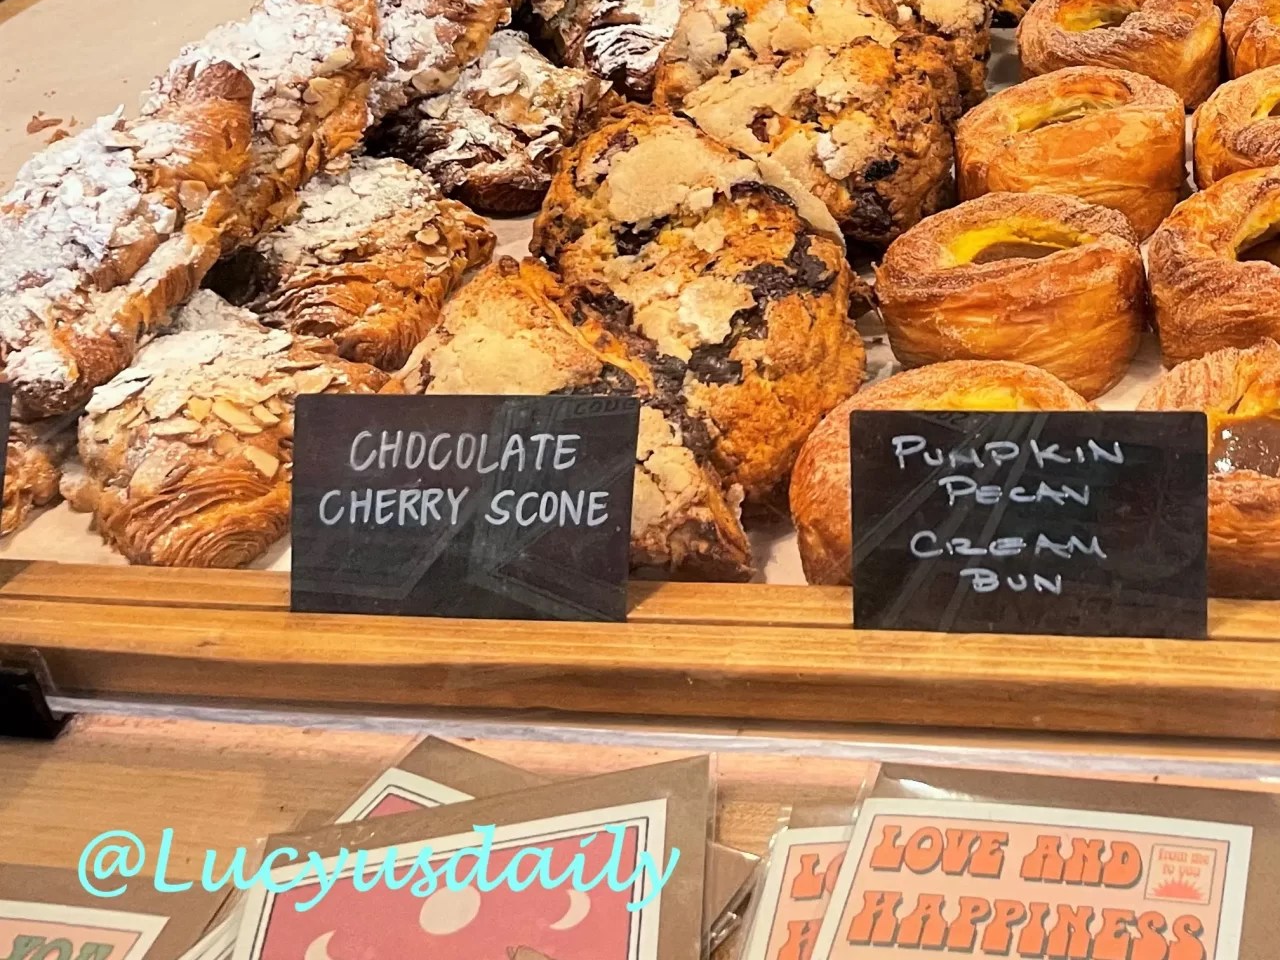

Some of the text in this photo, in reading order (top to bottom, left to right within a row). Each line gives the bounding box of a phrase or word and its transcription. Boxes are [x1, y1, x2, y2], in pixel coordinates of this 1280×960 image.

[350, 430, 581, 474] CHOCOLATE
[319, 486, 610, 527] CHERRY SCONE
[938, 475, 1090, 506] PECAN
[910, 530, 1108, 559] CREAM
[959, 567, 1062, 596] BUN
[869, 825, 1010, 878] LOVE
[1019, 835, 1144, 890] AND
[846, 890, 1208, 960] HAPPINESS
